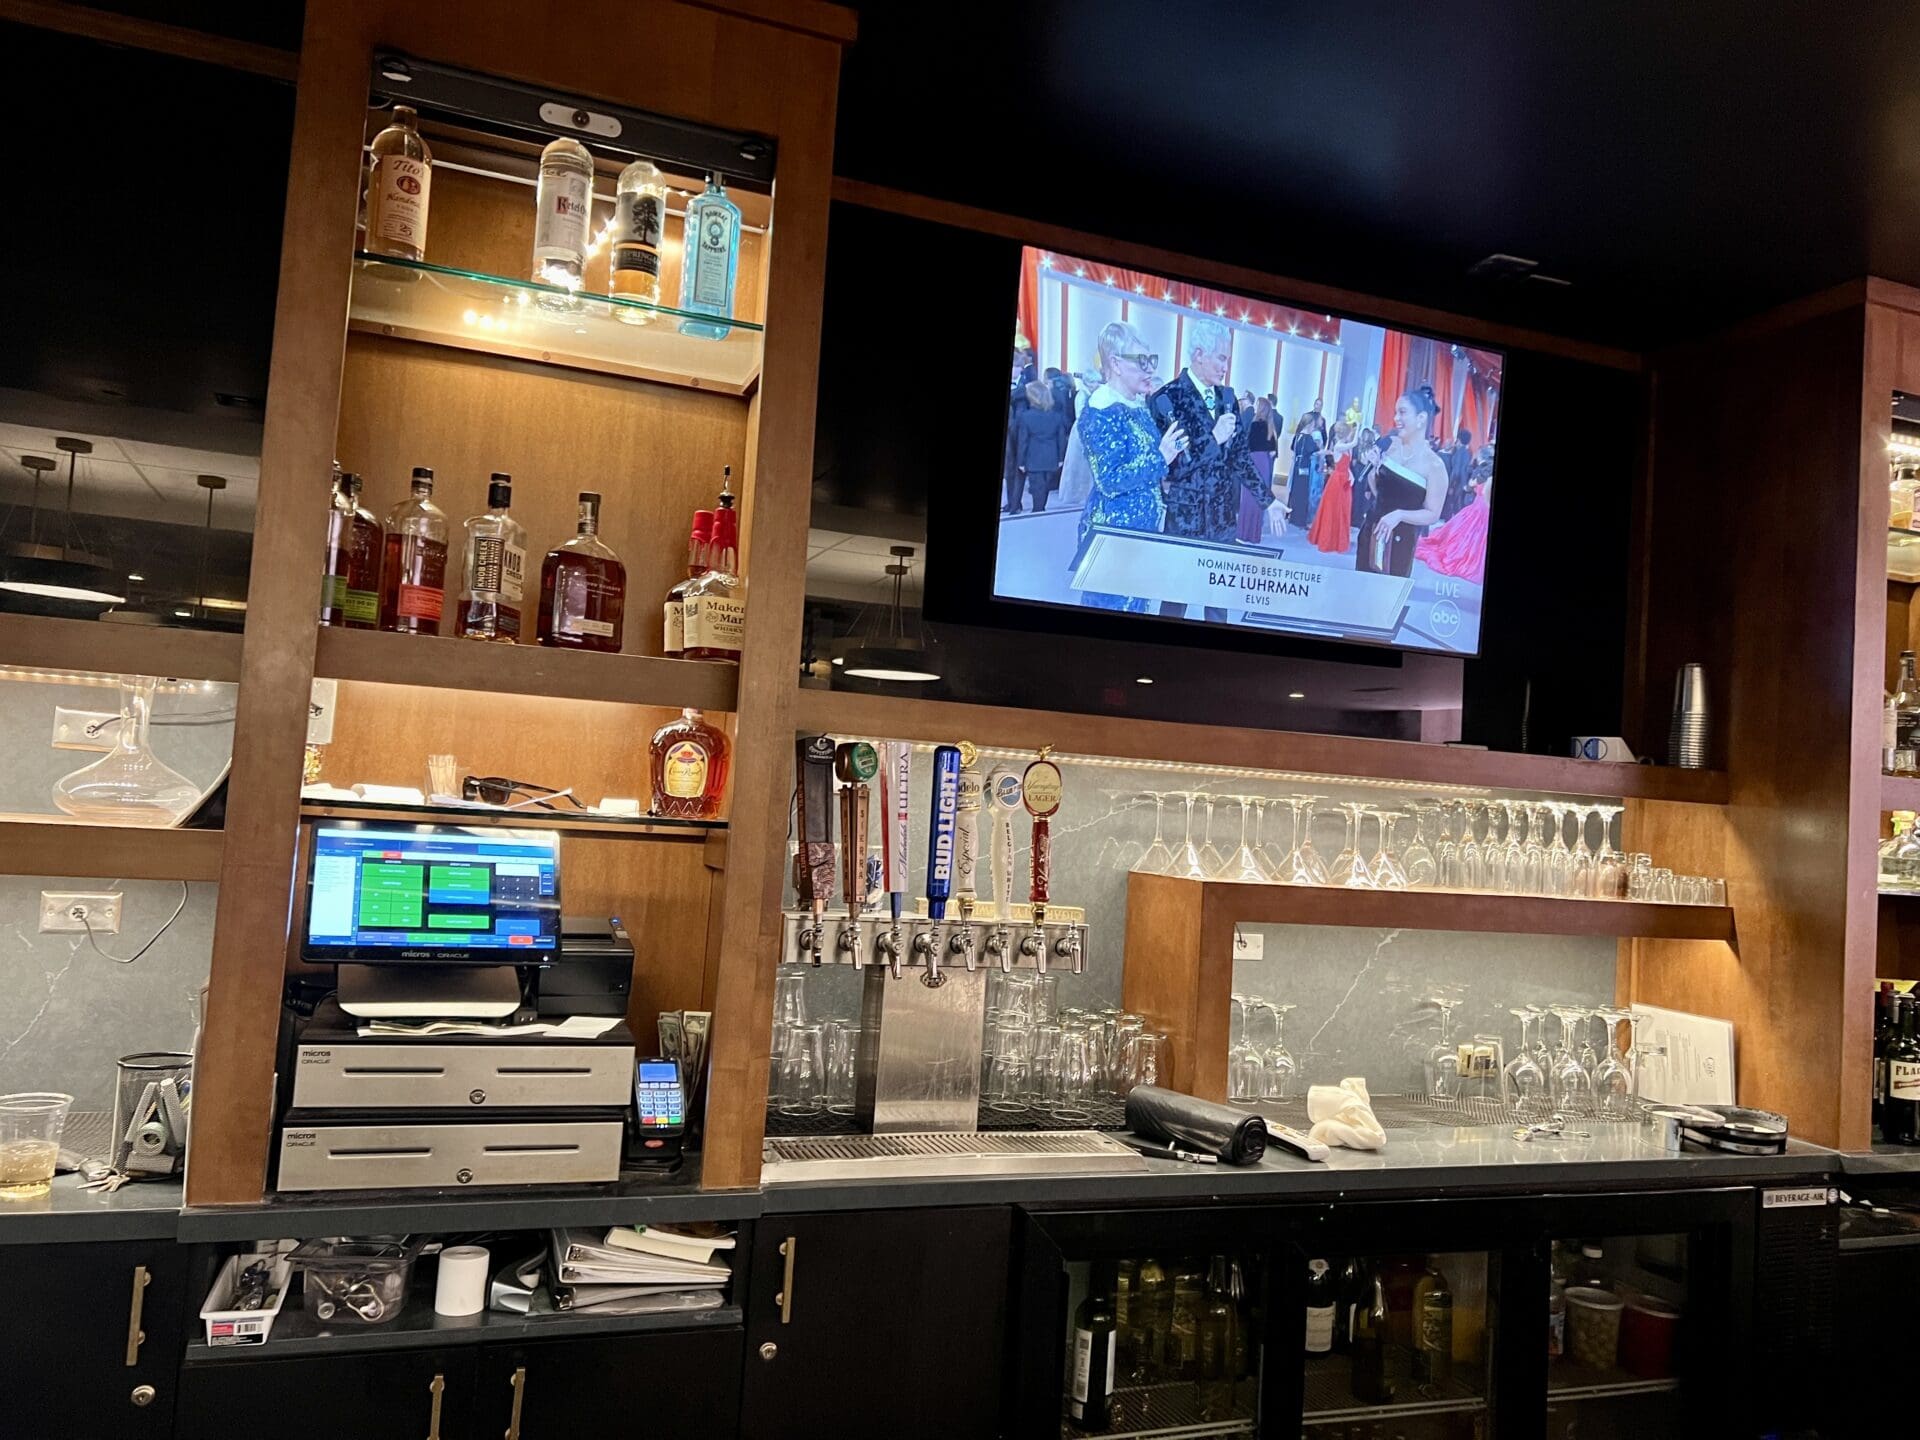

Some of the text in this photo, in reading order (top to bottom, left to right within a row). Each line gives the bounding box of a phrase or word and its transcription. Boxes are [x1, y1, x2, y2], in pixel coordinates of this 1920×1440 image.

[476, 540, 489, 588] KNOB CREEK
[1197, 558, 1322, 583] NOMINATED BEST PICTURE
[1209, 572, 1309, 597] BAZ LUHRMAN
[1435, 580, 1460, 598] LIVE
[1245, 594, 1270, 606] ELVIS
[706, 601, 744, 614] Maker
[720, 614, 744, 625] Mar
[1432, 610, 1458, 625] abc
[899, 752, 908, 809] ULTRA
[958, 780, 980, 793] delo
[1028, 794, 1058, 803] LAGER
[934, 767, 957, 880] BUD LIGHT
[401, 950, 430, 958] micros
[287, 1132, 316, 1140] micros
